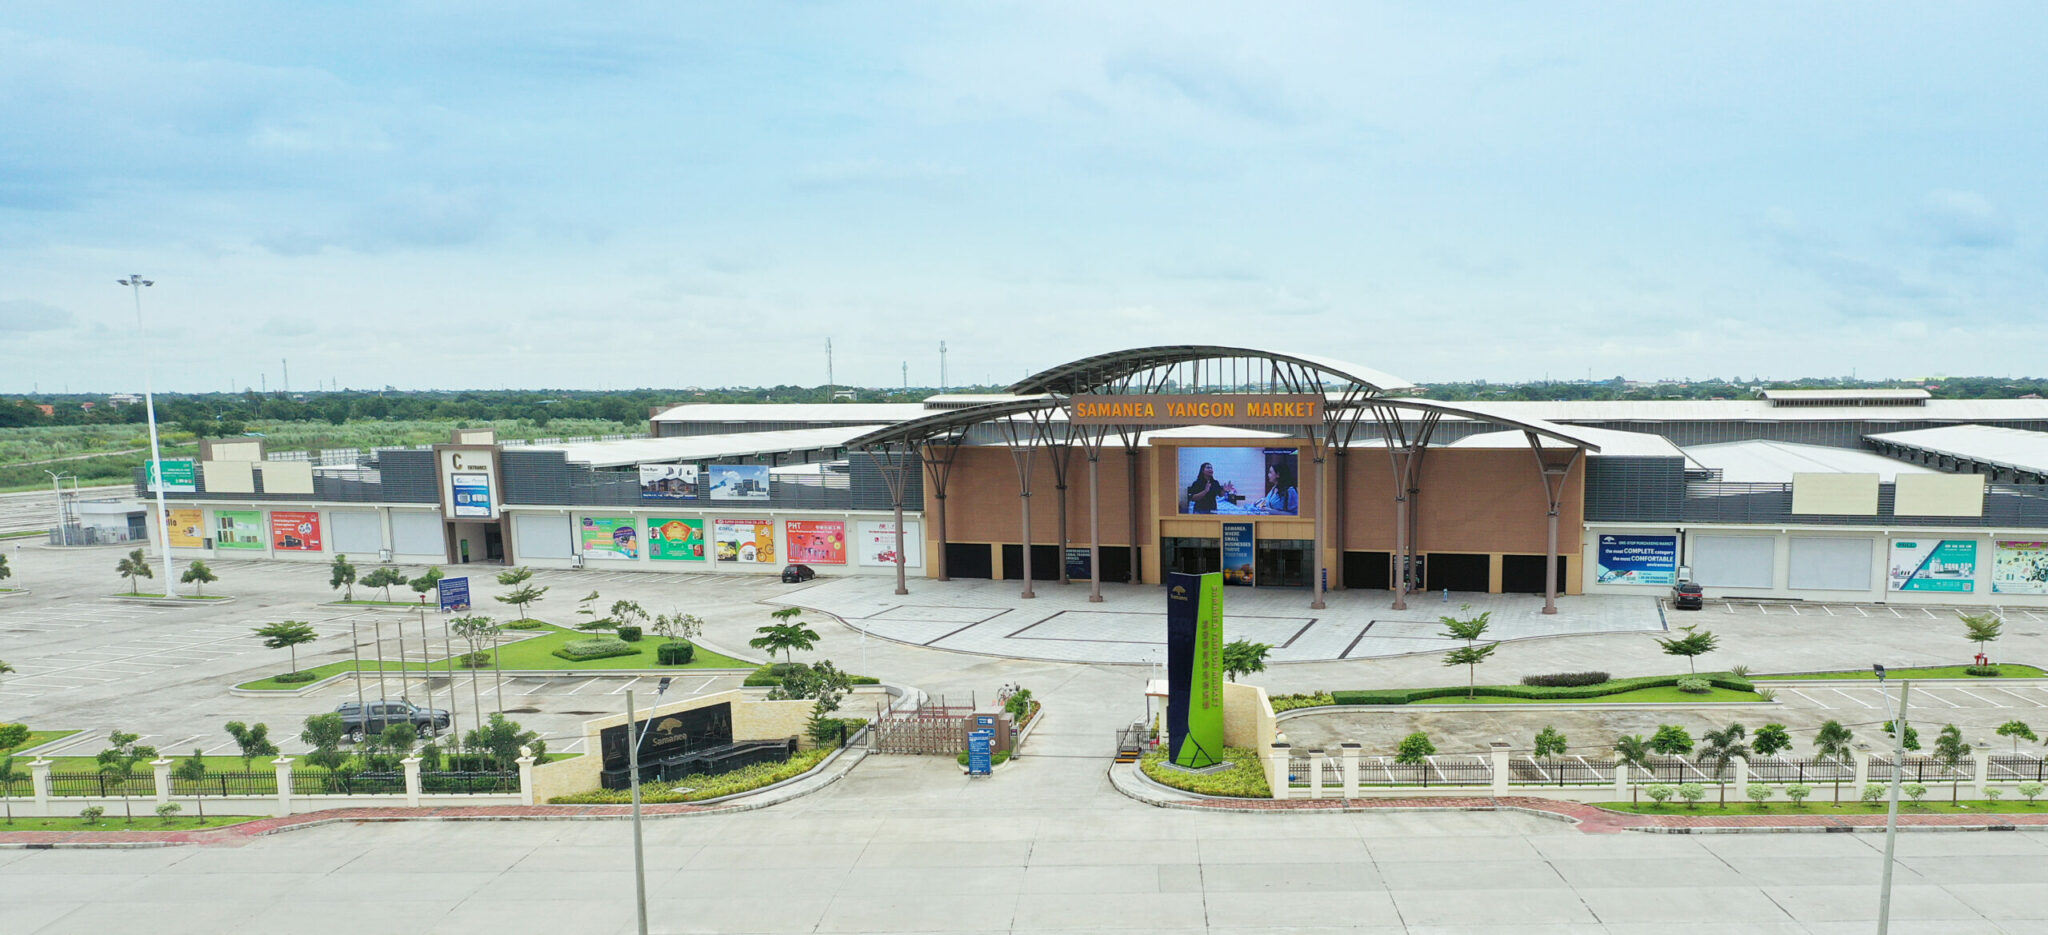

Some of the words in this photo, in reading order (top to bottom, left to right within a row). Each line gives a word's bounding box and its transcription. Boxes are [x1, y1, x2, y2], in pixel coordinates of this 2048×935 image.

[1077, 402, 1155, 417] SAMANEA
[1166, 402, 1235, 417] YANGON
[1247, 402, 1316, 417] MARKET
[453, 453, 463, 470] C
[653, 733, 688, 745] Samanea
